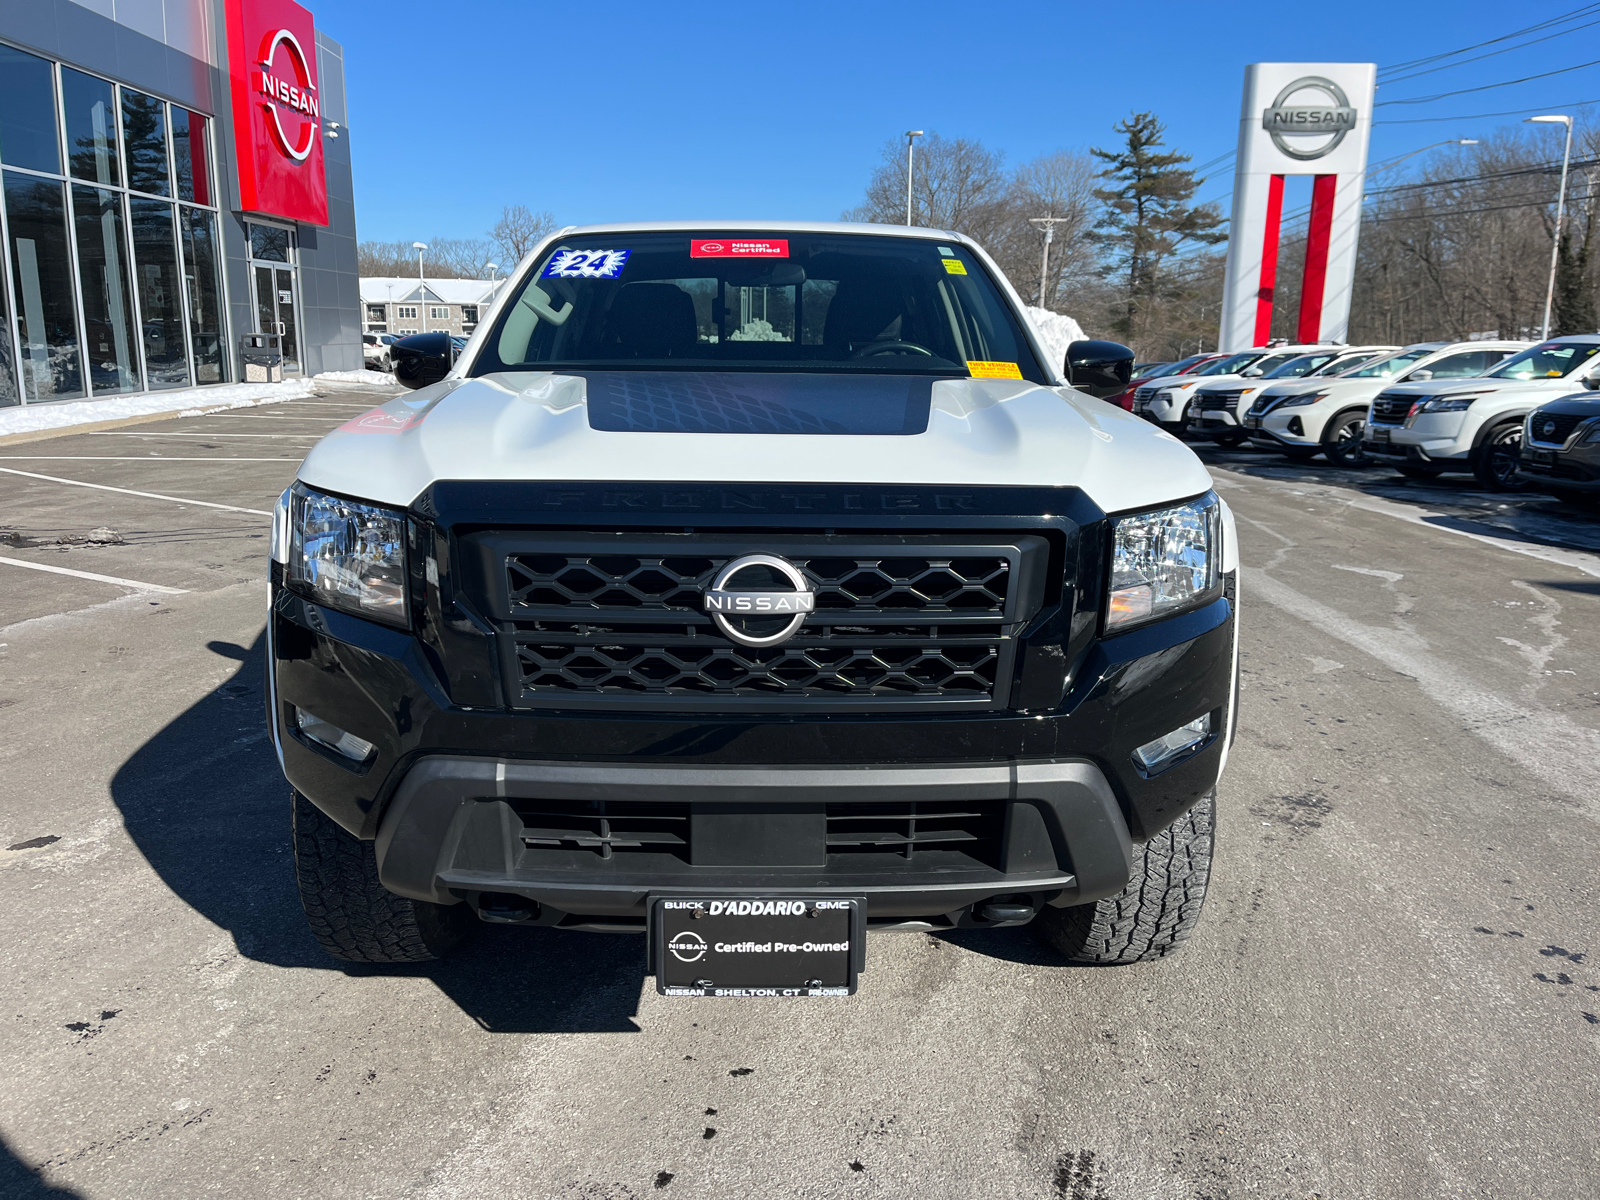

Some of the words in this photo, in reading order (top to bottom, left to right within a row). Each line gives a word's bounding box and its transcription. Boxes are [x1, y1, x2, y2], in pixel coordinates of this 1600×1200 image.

[262, 71, 319, 117] NISSAN
[1273, 111, 1350, 124] NISSAN
[564, 254, 608, 271] 24
[543, 489, 981, 511] FRONTIER
[706, 595, 814, 610] NISSAN
[709, 901, 806, 916] D'ADDARIO
[815, 901, 850, 909] GMC
[668, 942, 708, 950] NISSAN
[714, 942, 772, 953] Certified
[774, 941, 849, 952] Pre-Owned
[714, 989, 780, 997] SHELTON,
